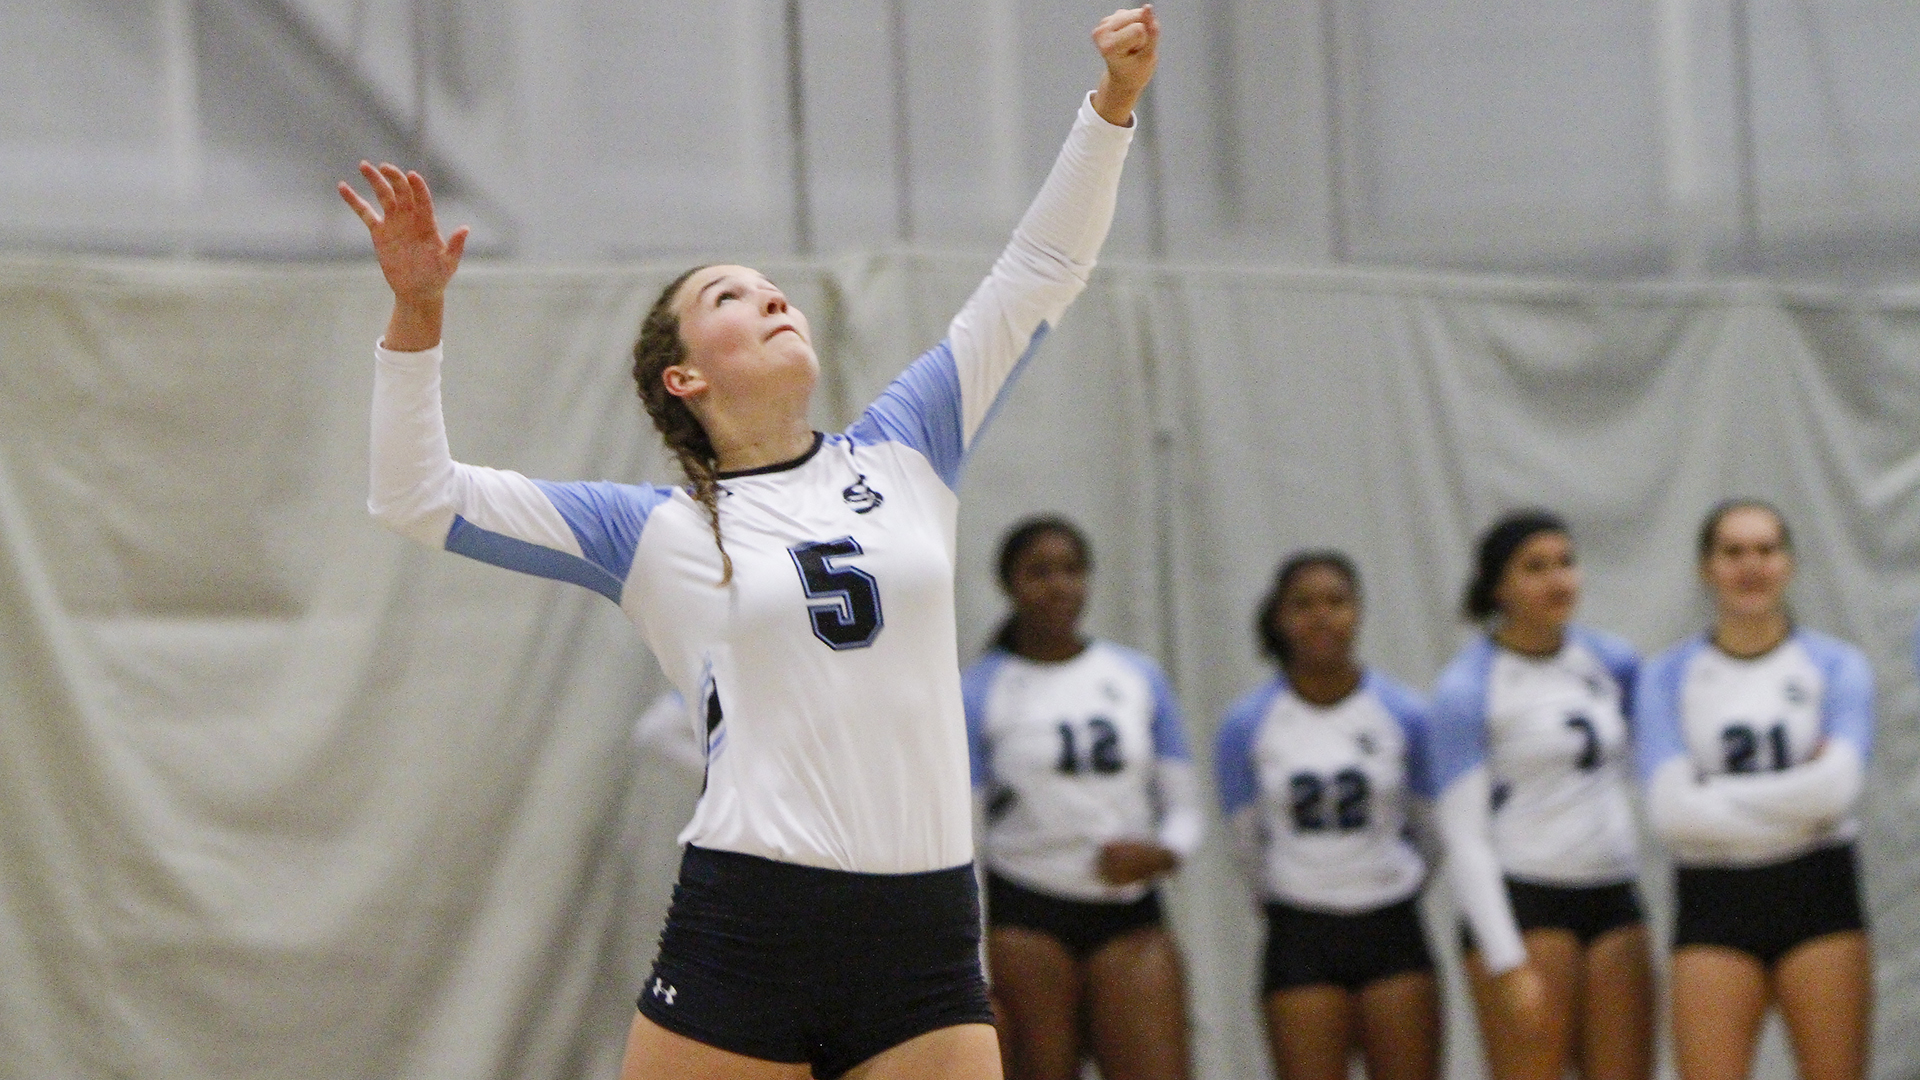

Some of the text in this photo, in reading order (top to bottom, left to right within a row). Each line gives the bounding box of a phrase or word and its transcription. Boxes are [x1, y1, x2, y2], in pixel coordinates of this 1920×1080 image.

[786, 536, 885, 651] 5
[1054, 717, 1125, 776] 12
[1721, 724, 1791, 773] 21
[1289, 768, 1369, 831] 22
